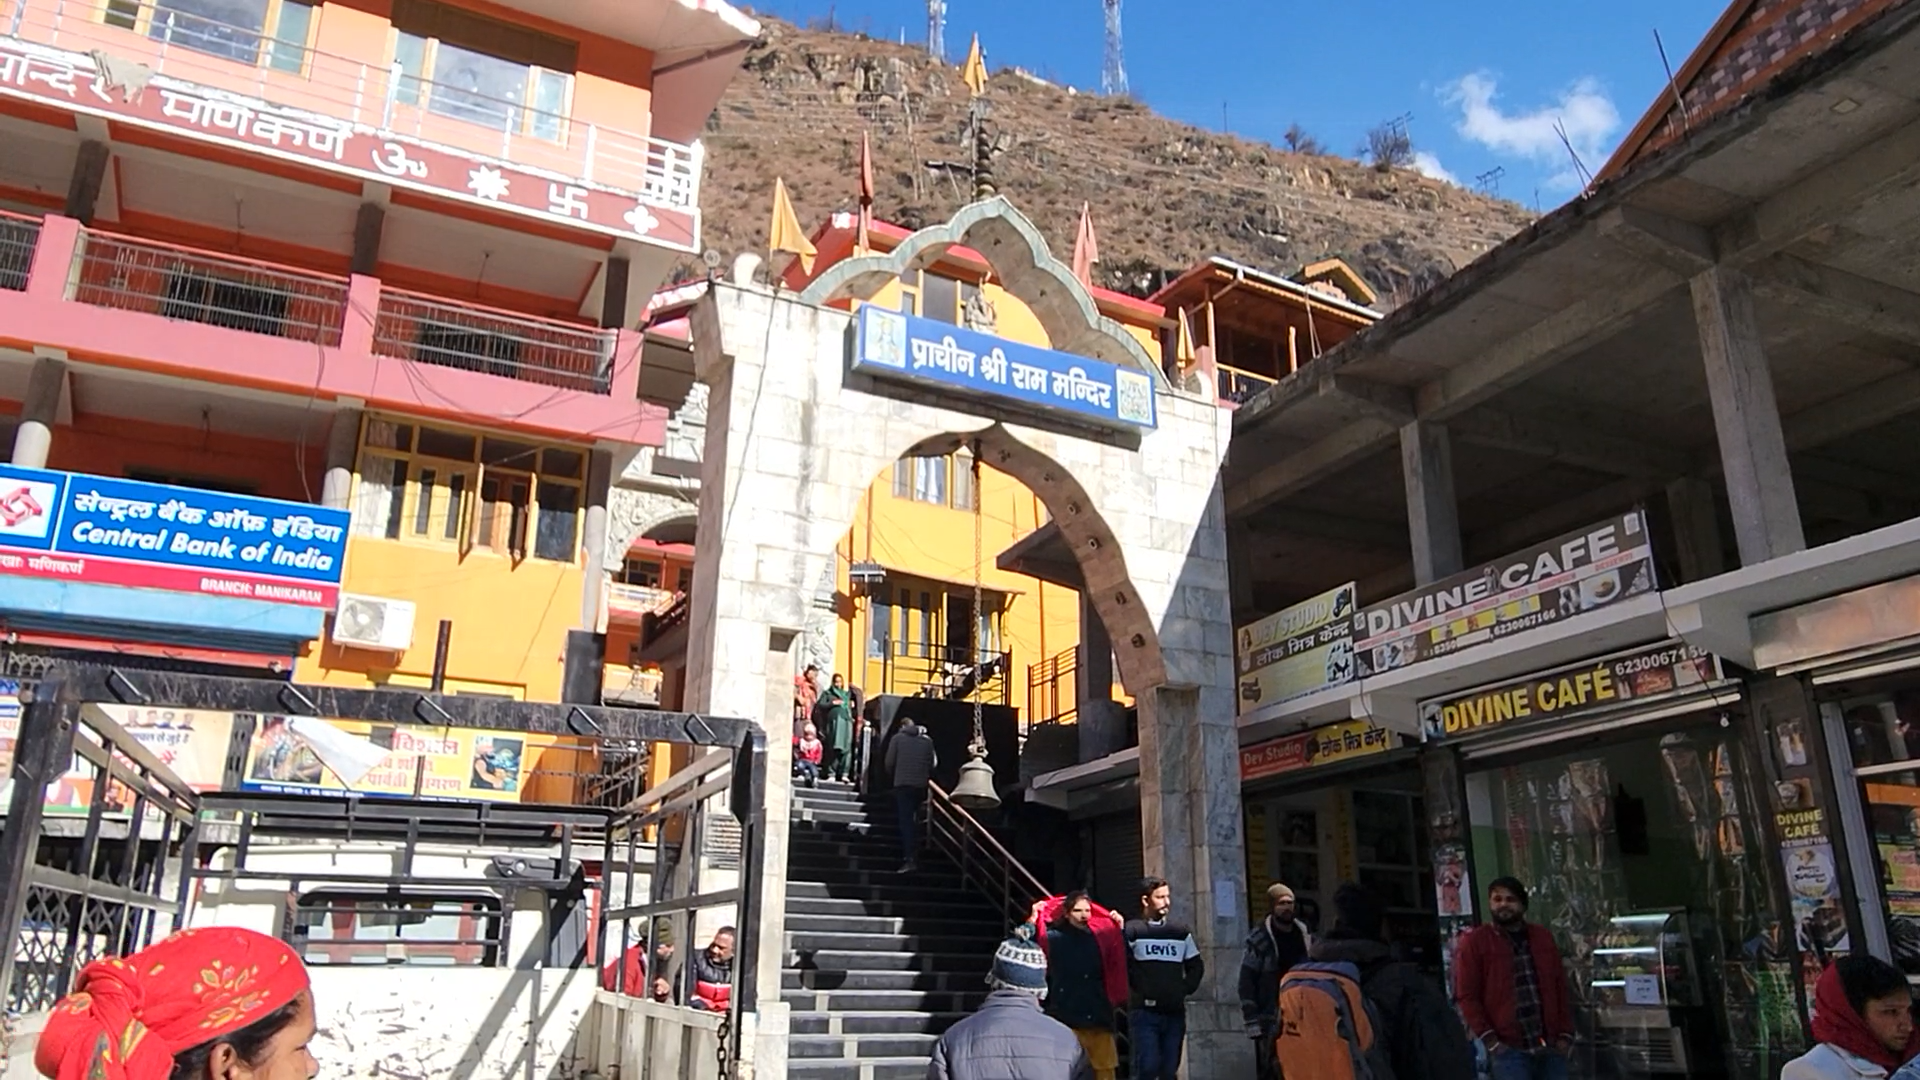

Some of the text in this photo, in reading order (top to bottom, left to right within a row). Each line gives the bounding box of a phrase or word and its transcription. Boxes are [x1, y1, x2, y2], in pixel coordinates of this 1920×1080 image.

[911, 335, 1112, 409] प्राचीन श्री राम मन्दिर
[72, 520, 334, 572] Central Bank of India
[272, 515, 344, 544] इंडिया
[200, 577, 323, 603] BRANCH: MANIKARAN
[1367, 577, 1490, 638] DIVINE
[1500, 524, 1620, 589] CAFE
[1444, 663, 1616, 733] DIVINE CAFÉ
[1244, 751, 1264, 766] Dev
[1266, 741, 1301, 761] Studio
[1776, 809, 1823, 826] DIVINE
